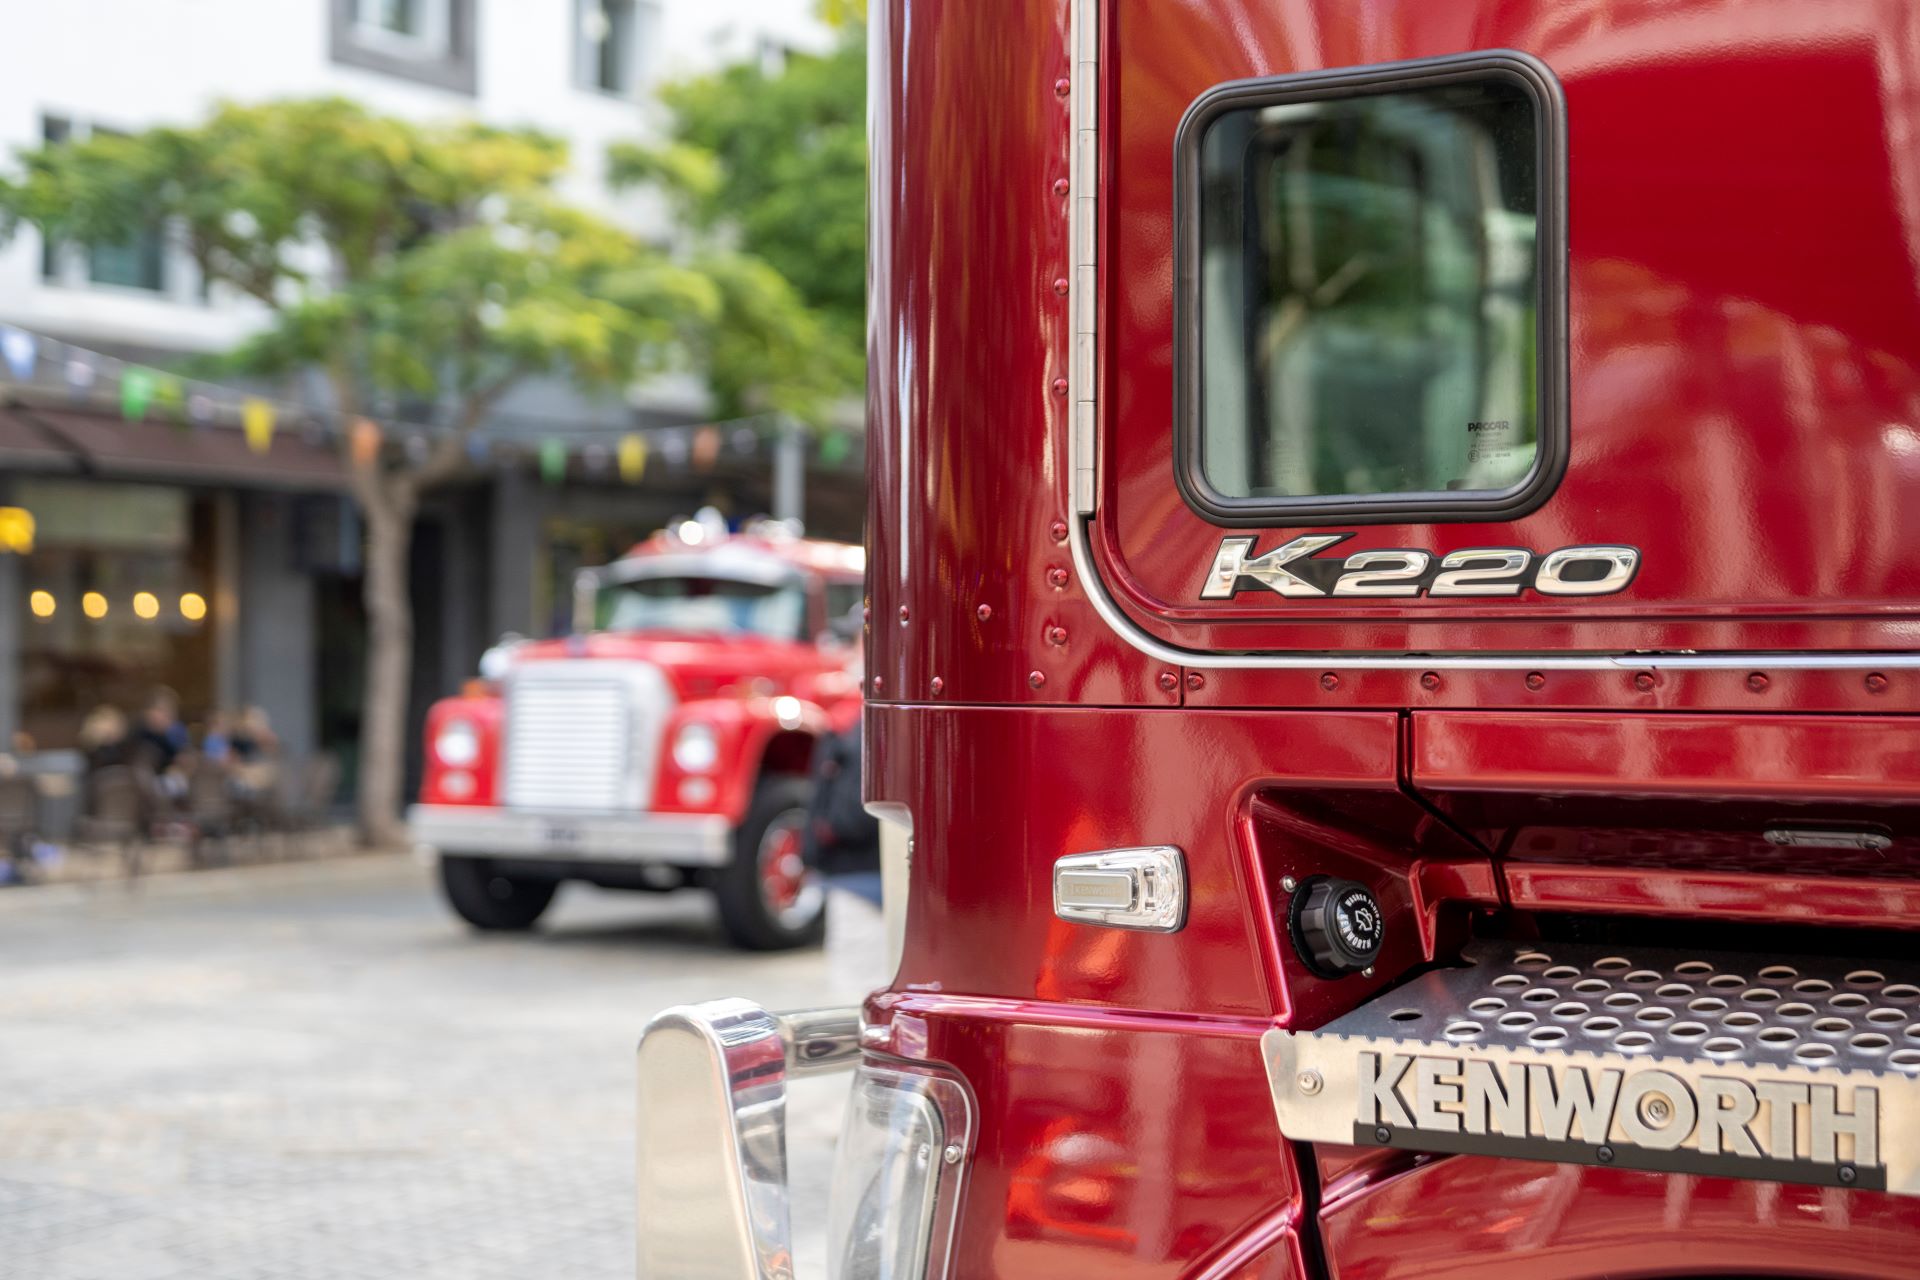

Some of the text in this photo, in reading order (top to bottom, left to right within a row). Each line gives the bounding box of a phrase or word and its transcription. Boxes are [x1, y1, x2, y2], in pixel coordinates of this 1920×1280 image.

[1467, 421, 1509, 432] PACCAR
[1200, 533, 1640, 598] K220
[1344, 893, 1367, 907] WASHER
[1358, 1051, 1877, 1166] KENWORTH
